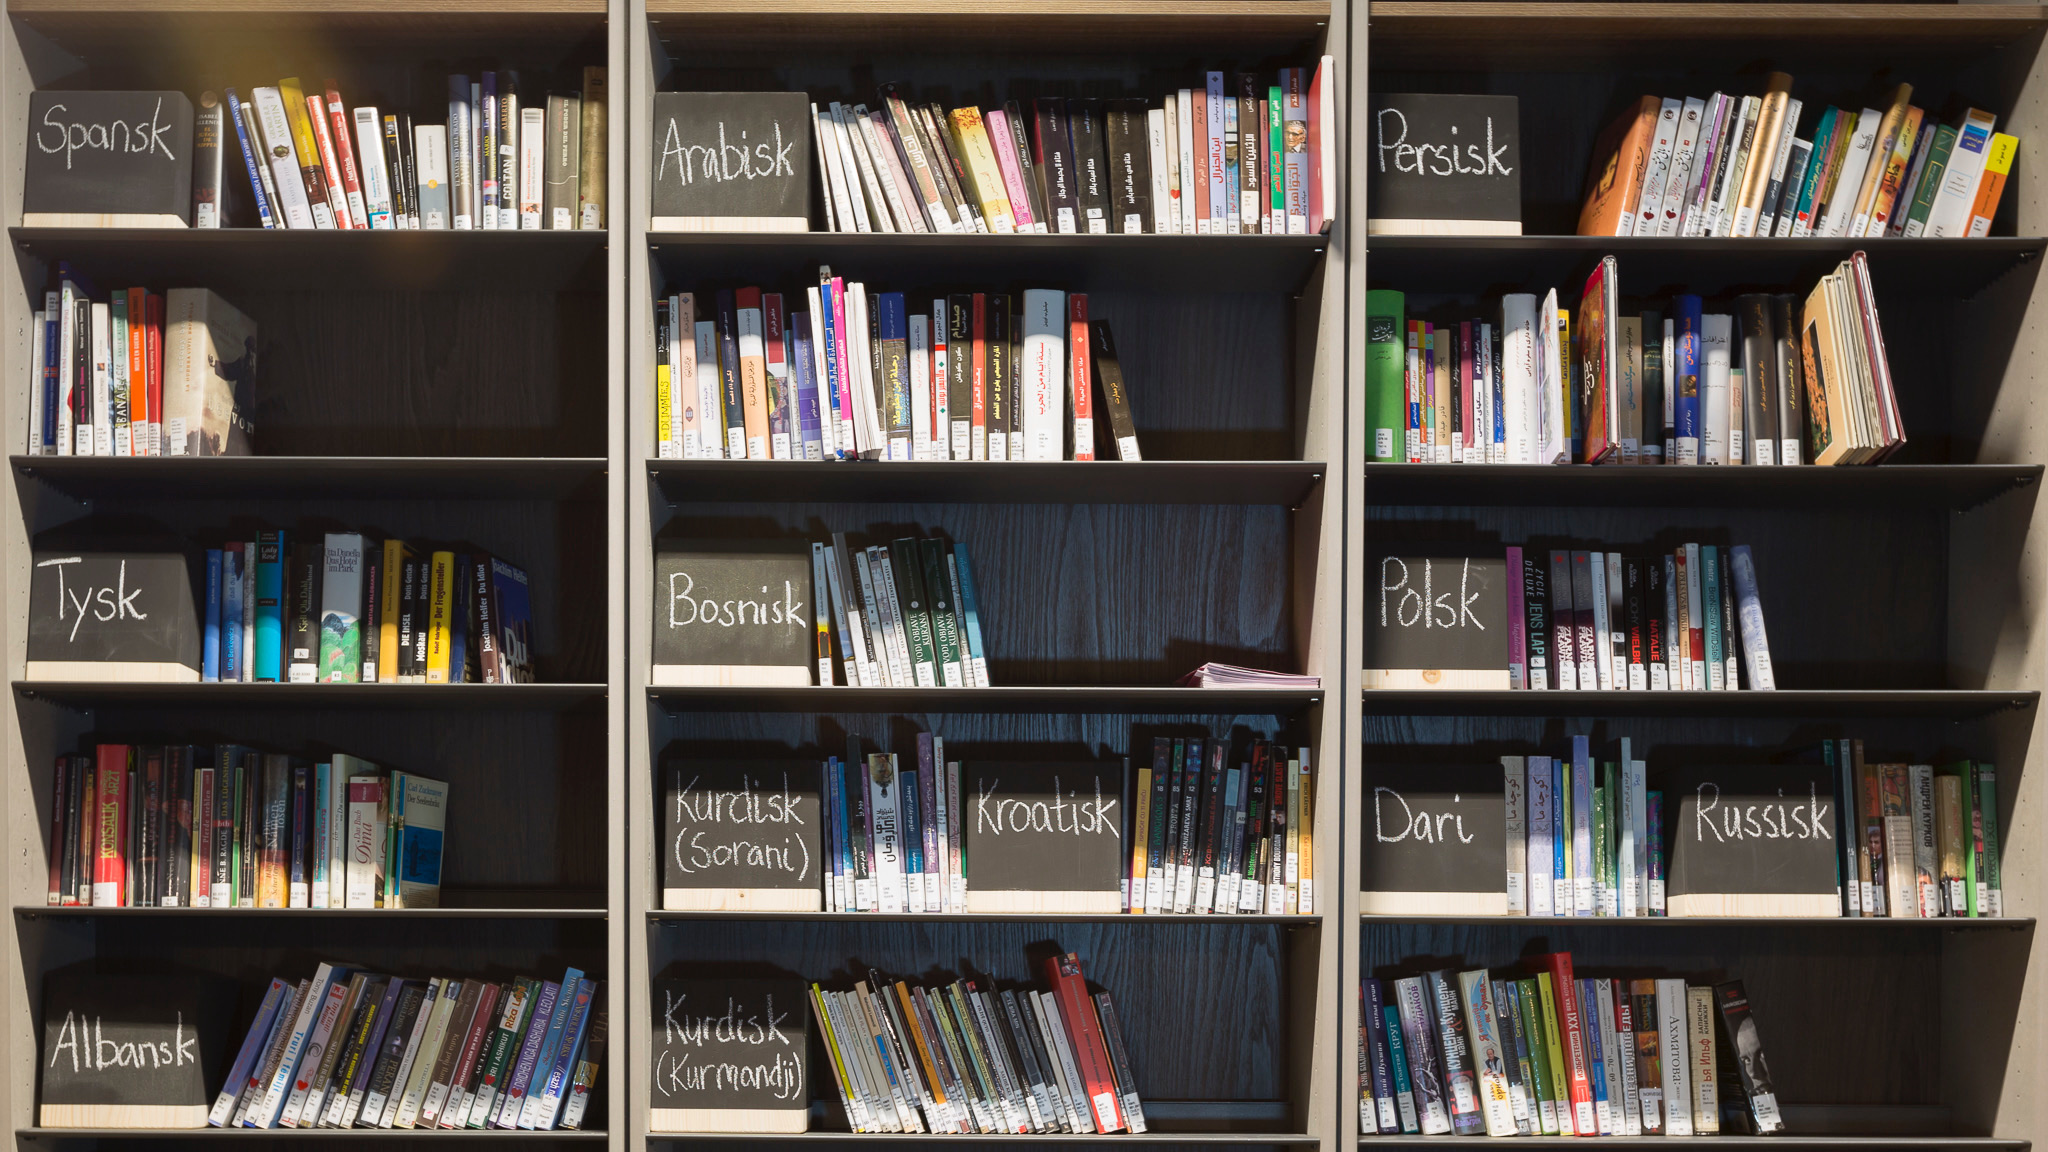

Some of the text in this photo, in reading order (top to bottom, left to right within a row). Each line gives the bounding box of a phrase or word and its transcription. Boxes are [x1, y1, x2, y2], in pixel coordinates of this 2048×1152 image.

[37, 97, 175, 170] Spansk
[271, 104, 286, 138] MARTIN
[659, 118, 794, 186] Arabisk
[1211, 136, 1224, 184] ابن الجنرال
[1378, 108, 1513, 176] Persisk
[502, 160, 514, 200] COLTAN
[1036, 342, 1044, 361] ستة
[890, 354, 902, 425] رحلة ابن بطوطة
[974, 387, 982, 409] العراق
[1036, 378, 1046, 388] من
[660, 380, 670, 430] DUMMIES
[1036, 390, 1046, 415] الحرب
[338, 564, 354, 572] Park
[1524, 560, 1534, 598] DELUXE
[1707, 560, 1715, 582] Mistrz
[37, 556, 147, 642] Tysk
[478, 582, 486, 594] Du
[670, 572, 806, 628] Bosnisk
[1381, 556, 1486, 631] Polsk
[299, 614, 308, 632] Kjell
[434, 600, 444, 619] Der
[480, 596, 493, 652] Joachim Helfer
[910, 614, 920, 642] OBJAVE
[936, 614, 946, 642] OBJAVE
[1680, 612, 1688, 632] MIMO
[401, 613, 410, 646] DIE INSEL
[416, 632, 426, 662] Moskau
[504, 626, 527, 667] Du
[108, 770, 120, 795] ARZT
[676, 770, 804, 824] Kurdisk
[1275, 762, 1284, 805] SIROVE SLASTI
[202, 790, 211, 842] Pferde stehlen
[353, 810, 362, 840] Das Buch
[978, 776, 1119, 838] Kroatisk
[1182, 795, 1192, 850] KNJIŽAREVA SMRT
[1375, 786, 1474, 844] Dari
[1696, 782, 1833, 842] Russisk
[100, 802, 116, 858] KONSALIK
[220, 830, 228, 857] RAGDE
[354, 822, 372, 864] Dina
[1138, 819, 1146, 842] ISPRIČAT
[1272, 834, 1282, 862] BOURDAIN
[1922, 816, 1933, 848] КУРКОВ
[675, 827, 808, 882] (Sorani)
[1204, 838, 1213, 864] KOBNA
[304, 978, 324, 1014] Tony Buzan
[504, 1010, 517, 1029] Riza
[665, 989, 790, 1047] Kurdisk
[1696, 998, 1704, 1035] ЗАПИСНЫЕ
[1702, 1004, 1710, 1034] КНИЖКИ
[50, 1009, 195, 1074] Albansk
[288, 1032, 304, 1054] Truri
[1390, 1022, 1402, 1049] КРУГ
[1621, 1004, 1636, 1099] ПЕСНИ ПОБЕДЫ
[1698, 1038, 1712, 1066] Ильф
[1571, 1032, 1585, 1079] ИЗОБРЕТЕНИЯ
[656, 1050, 801, 1100] (Kurmandji)
